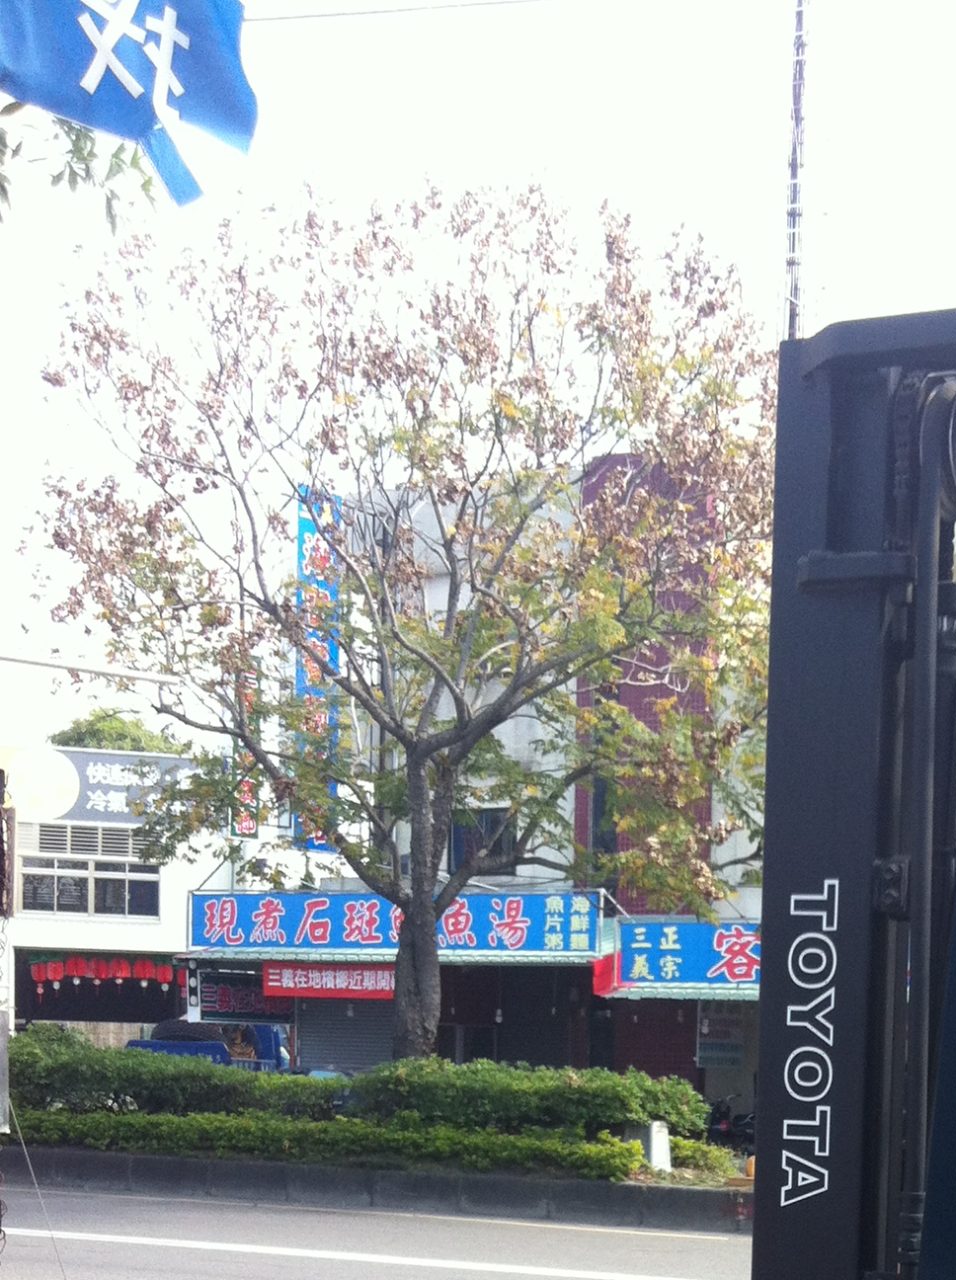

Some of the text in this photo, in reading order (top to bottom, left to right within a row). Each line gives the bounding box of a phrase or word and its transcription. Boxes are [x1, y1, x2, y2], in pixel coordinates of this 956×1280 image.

[204, 897, 530, 949] 現煮石斑魚湯
[268, 968, 395, 991] 三義在地檳榔近期開
[780, 879, 839, 1207] TOYOTA
